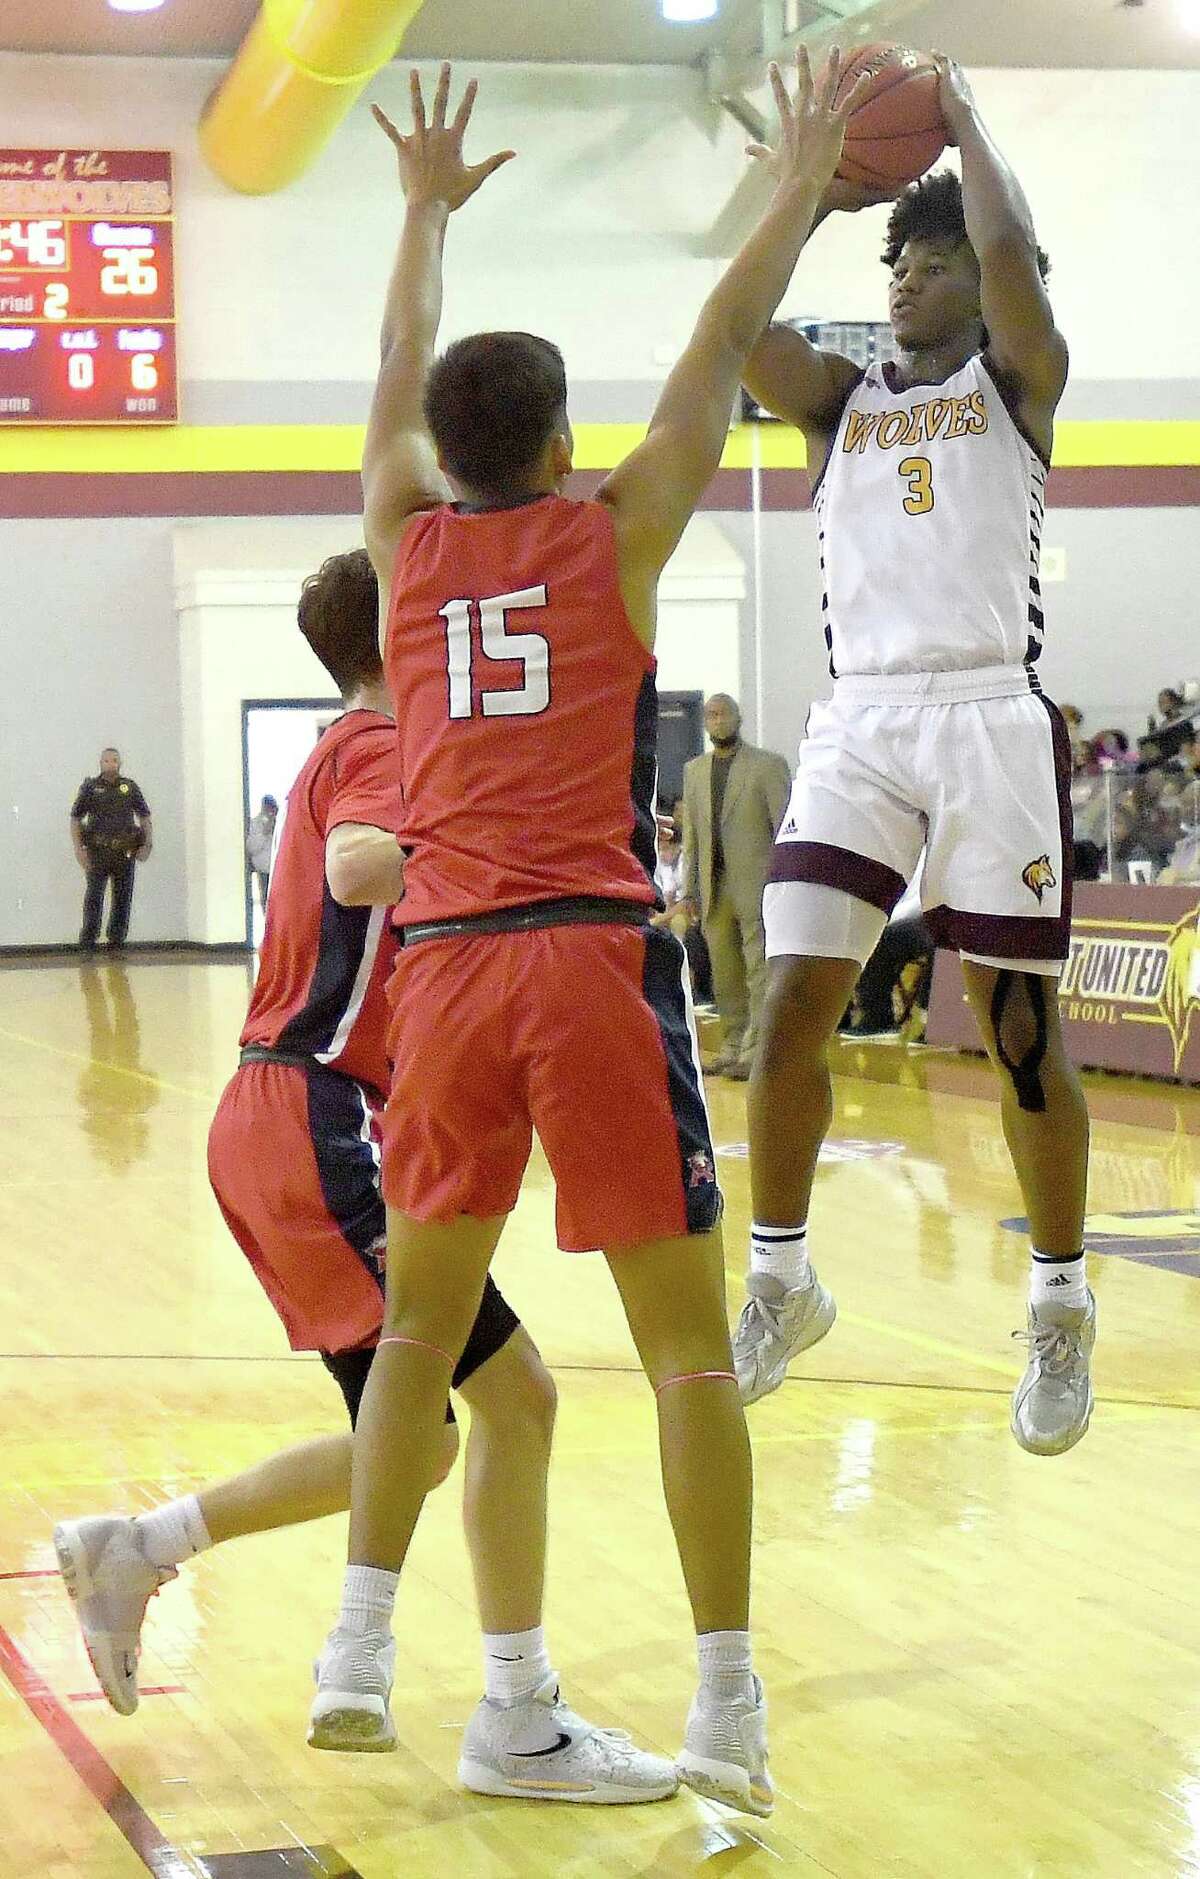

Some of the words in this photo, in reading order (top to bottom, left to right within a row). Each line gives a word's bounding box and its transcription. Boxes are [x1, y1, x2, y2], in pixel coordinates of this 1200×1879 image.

[42, 152, 66, 181] of
[74, 152, 108, 176] the
[101, 248, 158, 294] 26
[44, 283, 69, 319] 2
[68, 353, 94, 389] 0
[131, 353, 158, 389] 6
[842, 390, 988, 454] WOLVES
[898, 456, 935, 516] 3
[438, 583, 550, 718] 15
[1082, 943, 1168, 998] UNITED
